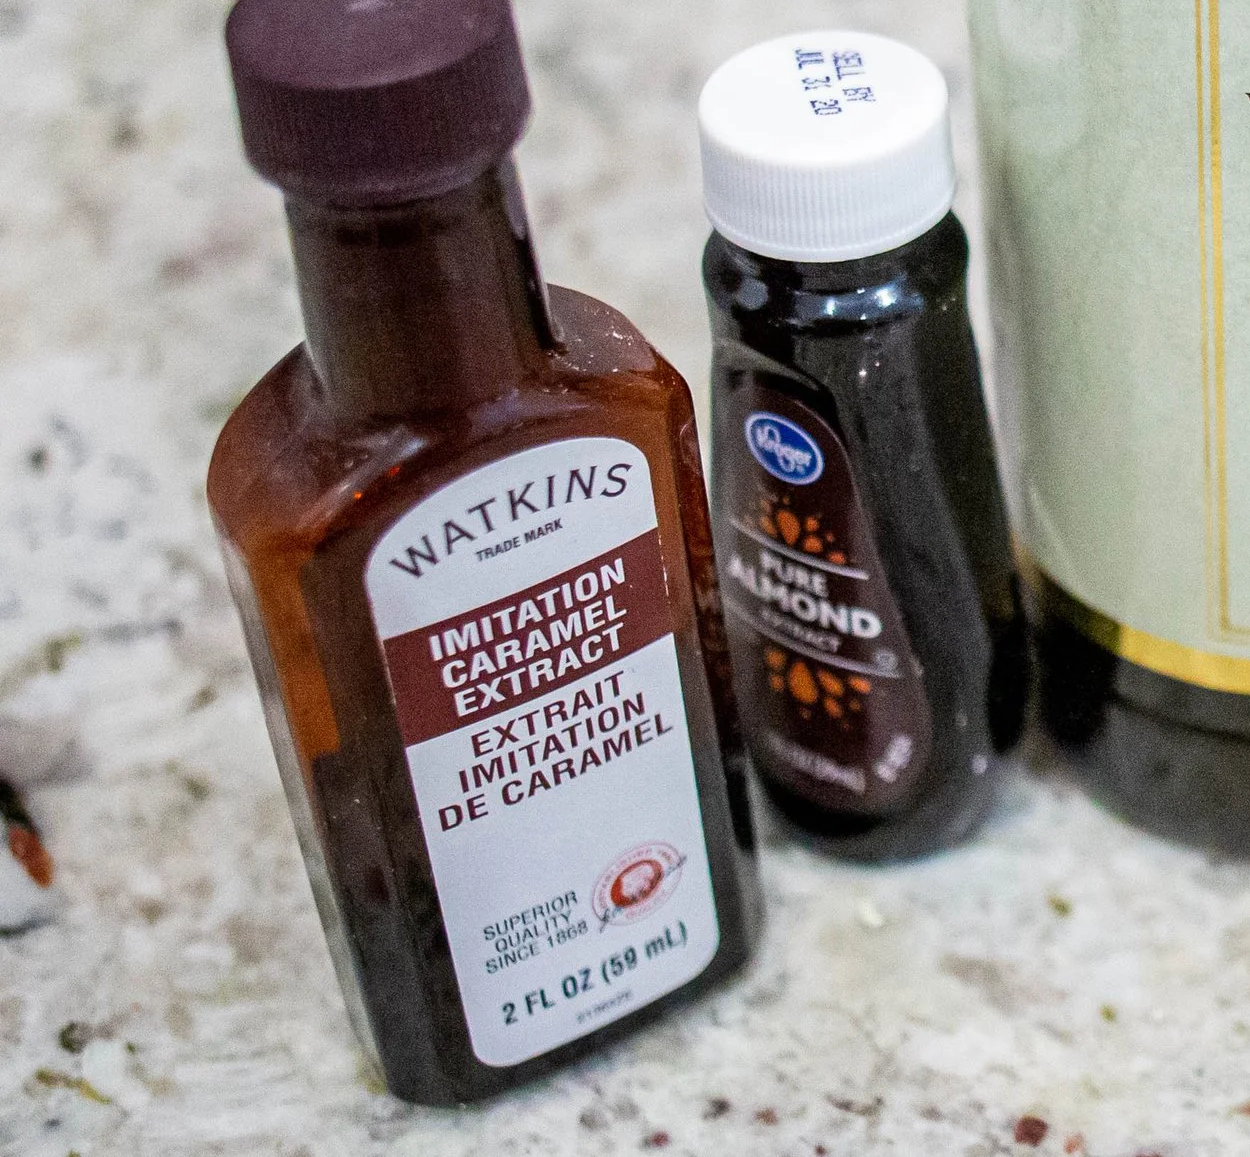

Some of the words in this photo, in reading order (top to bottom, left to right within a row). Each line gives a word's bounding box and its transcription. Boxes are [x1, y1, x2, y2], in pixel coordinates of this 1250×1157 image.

[389, 462, 633, 579] WATKINS
[475, 534, 522, 563] TRADE
[524, 517, 564, 544] MARK
[428, 557, 628, 662] IMITATION
[441, 597, 628, 689] CARAMEL
[727, 554, 883, 640] ALMOND
[453, 622, 625, 718] EXTRACT
[470, 670, 625, 759] EXTRAIT
[438, 793, 490, 833] DE
[500, 712, 674, 807] CARAMEL
[458, 691, 648, 795] IMITATION
[482, 890, 579, 942] SUPERIOR
[484, 944, 541, 975] SINCE
[494, 910, 573, 954] QUALITY
[502, 1000, 518, 1026] 2
[524, 987, 555, 1016] FL
[561, 967, 595, 1000] OZ
[600, 946, 638, 984] (59
[645, 919, 689, 961] mL)
